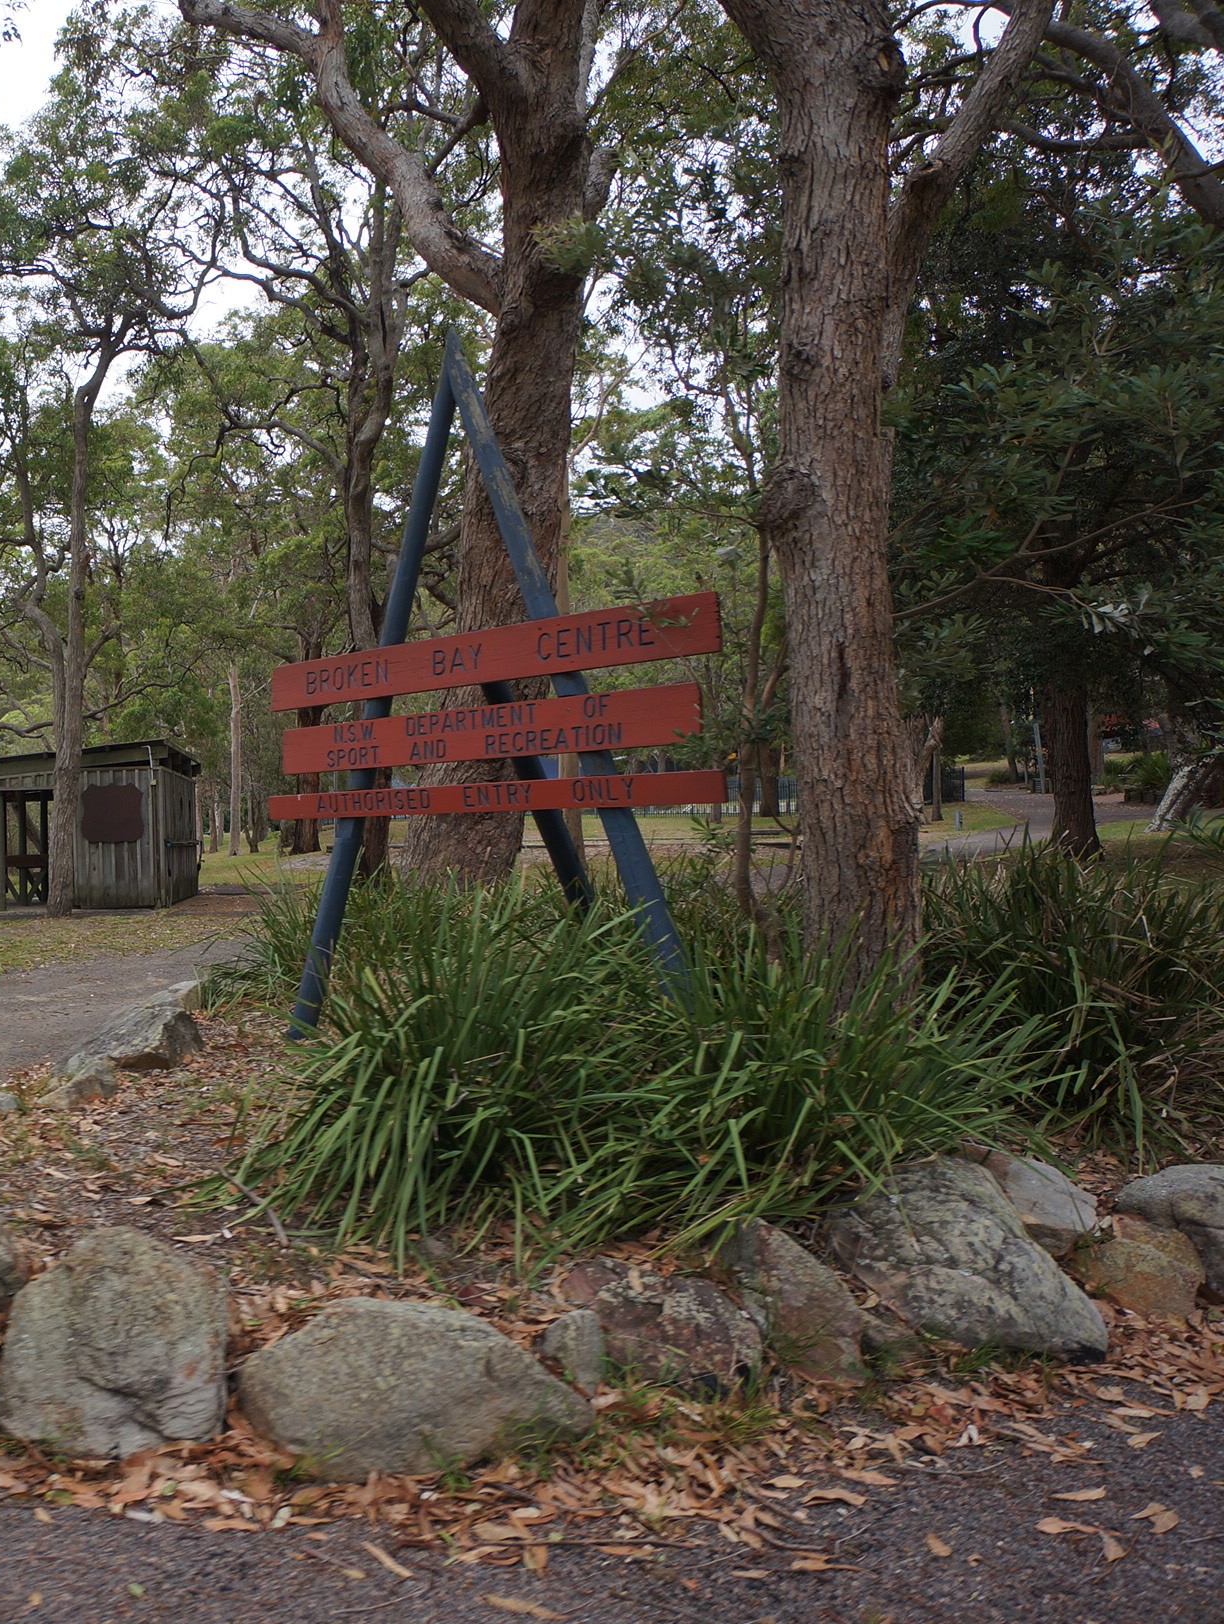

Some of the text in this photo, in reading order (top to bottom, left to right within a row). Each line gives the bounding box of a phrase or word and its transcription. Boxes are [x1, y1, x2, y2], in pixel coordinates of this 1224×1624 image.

[305, 616, 655, 696] BROKEN BAY CENTRE
[405, 703, 537, 738] DEPARTMENT
[583, 694, 612, 719] OF
[326, 722, 623, 768] SPORT AND RECREATION
[316, 777, 635, 814] AUTHORISED ENTRY ONLY
